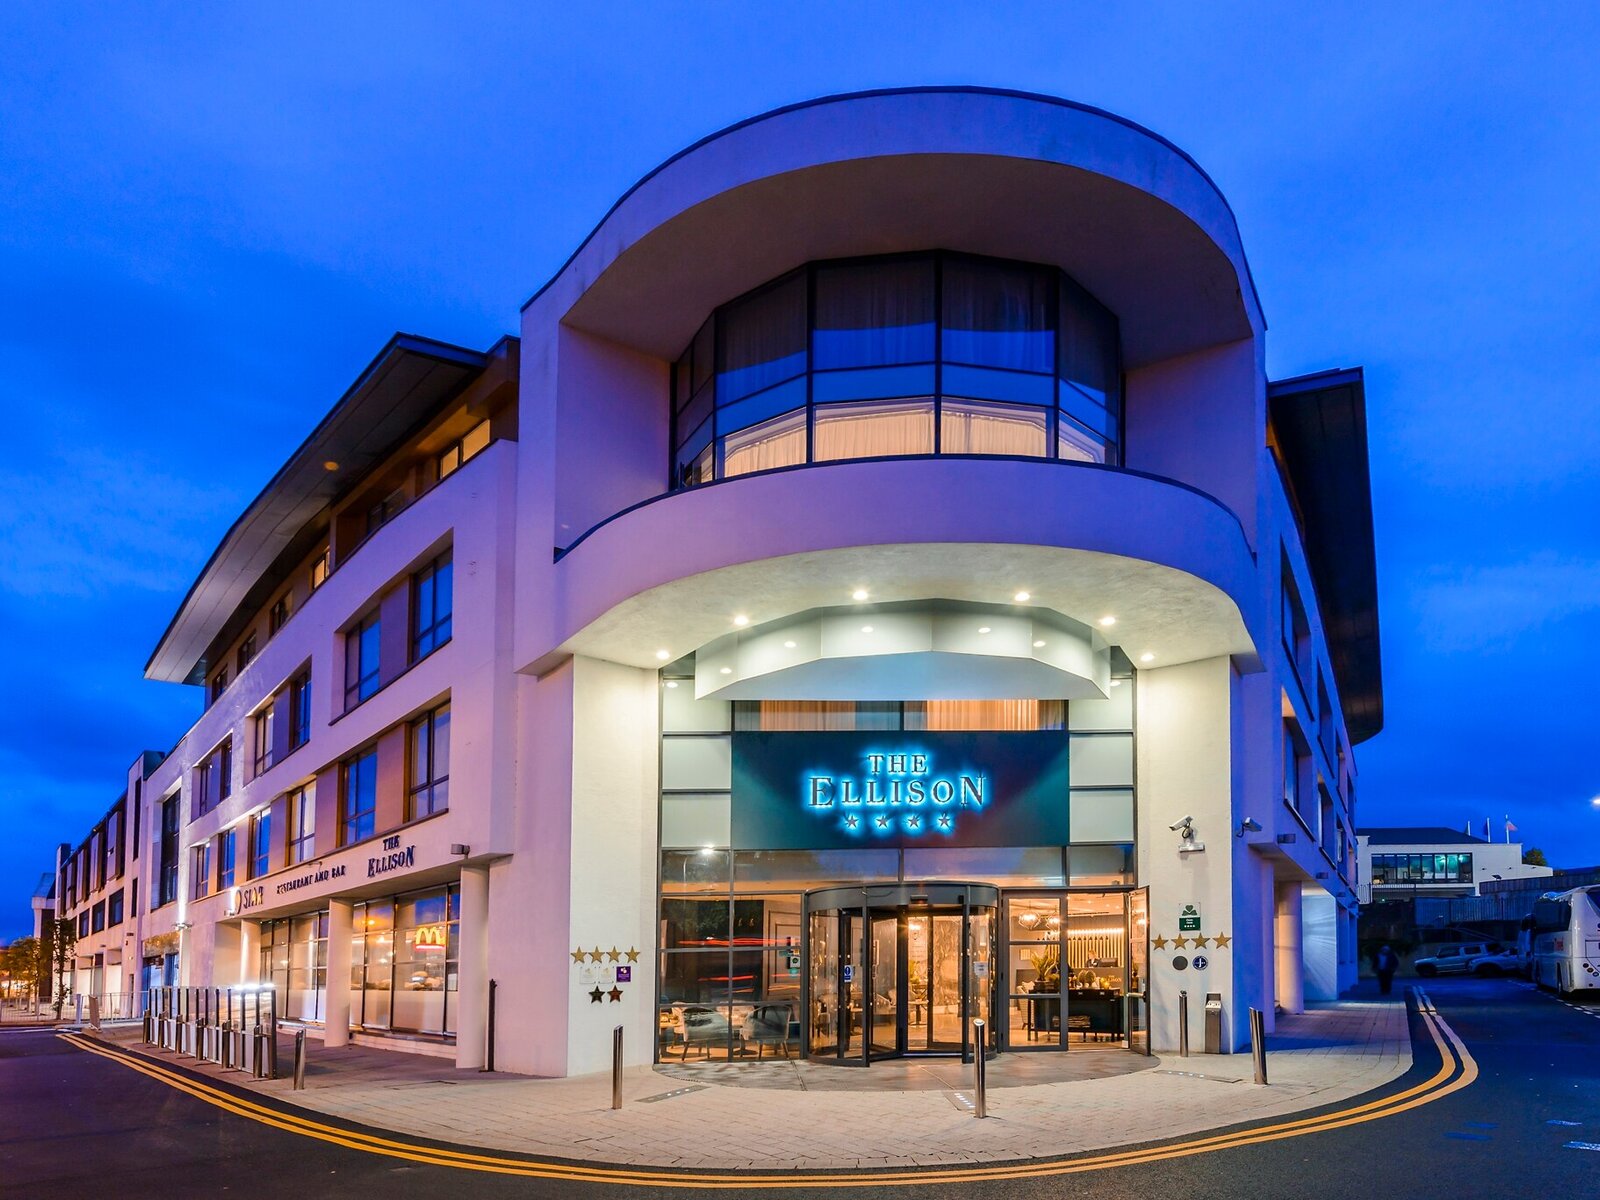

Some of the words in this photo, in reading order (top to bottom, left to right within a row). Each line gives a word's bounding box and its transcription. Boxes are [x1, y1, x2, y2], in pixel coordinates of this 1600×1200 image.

[868, 754, 928, 774] THE
[808, 774, 986, 808] ELLISON
[383, 835, 400, 851] THE
[367, 845, 416, 878] ELLISON
[276, 874, 314, 895] RESTAURANT
[314, 870, 329, 883] AND
[331, 864, 346, 879] BAR
